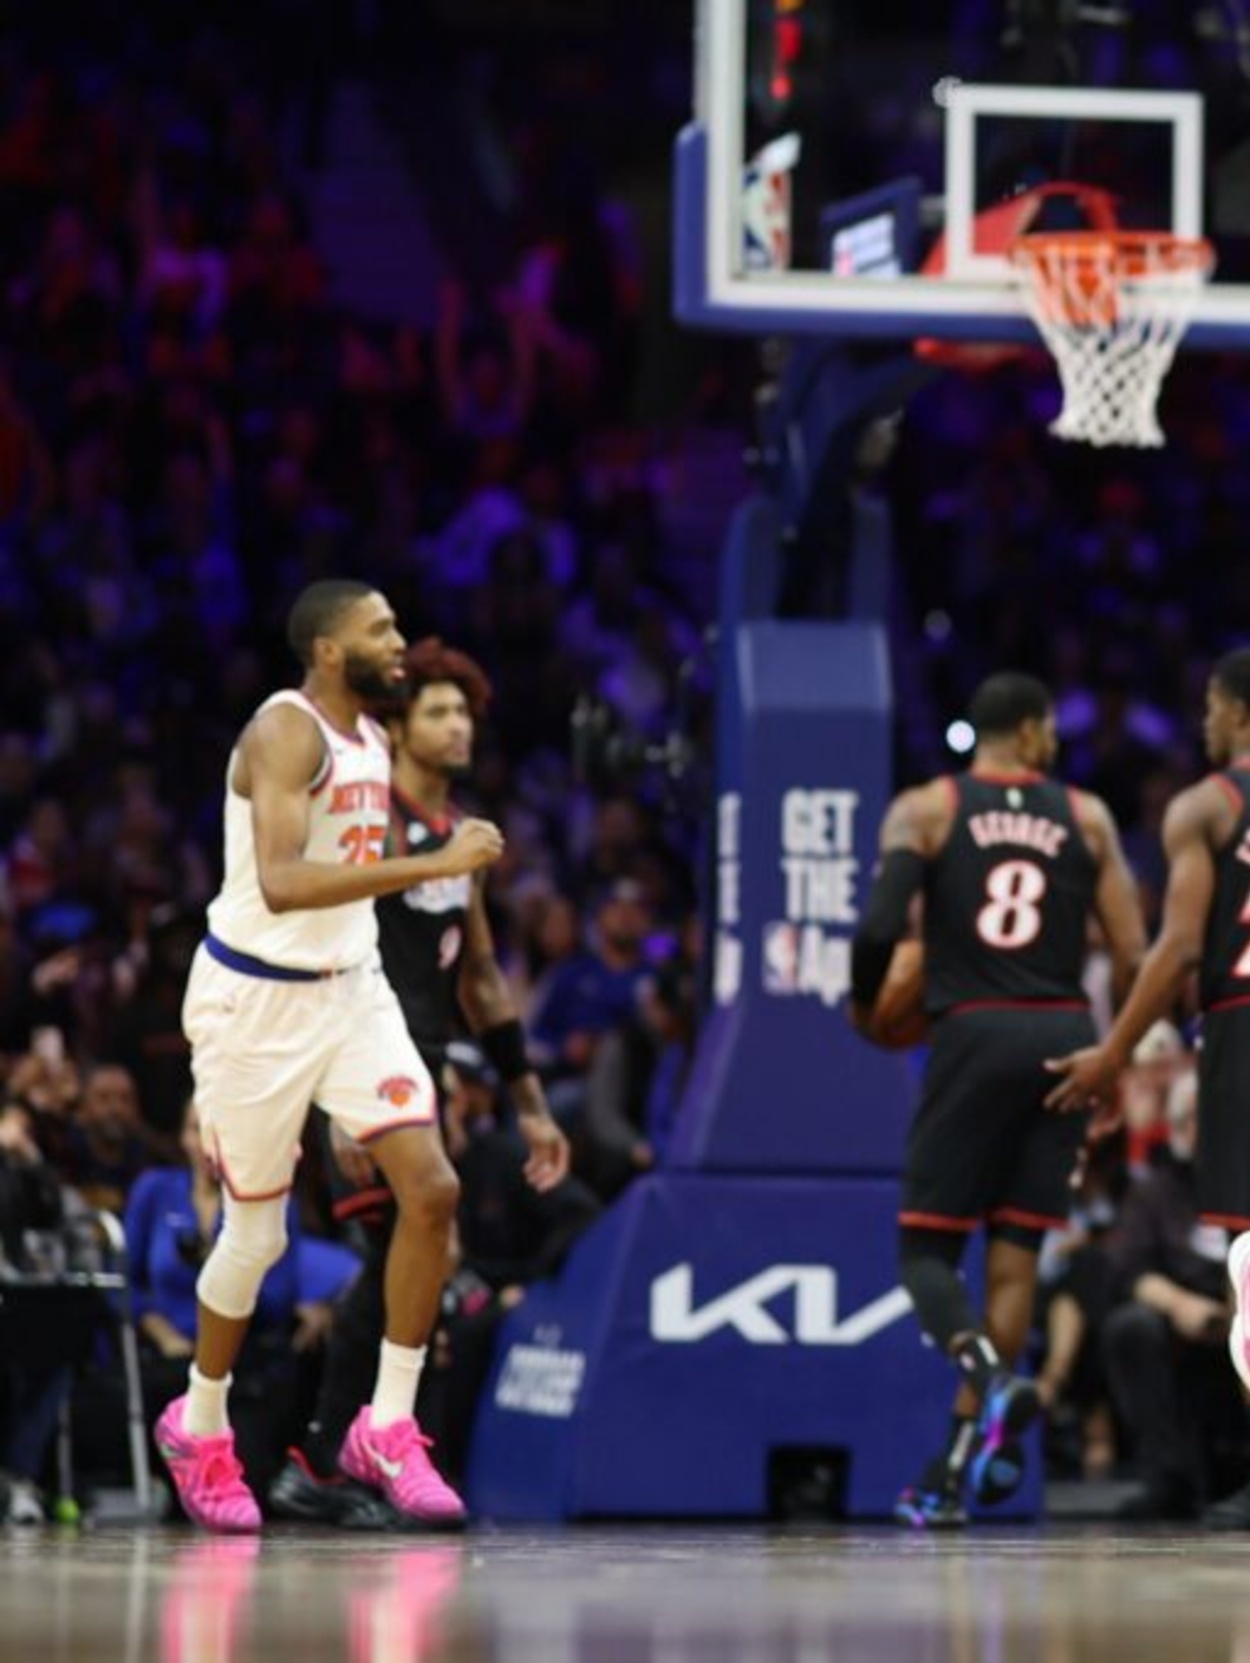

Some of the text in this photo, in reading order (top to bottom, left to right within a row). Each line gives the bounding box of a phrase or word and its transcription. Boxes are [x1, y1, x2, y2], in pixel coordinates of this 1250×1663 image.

[782, 788, 859, 855] GET
[968, 809, 1068, 858] GEORGE
[782, 856, 859, 923] THE
[975, 860, 1047, 950] 8
